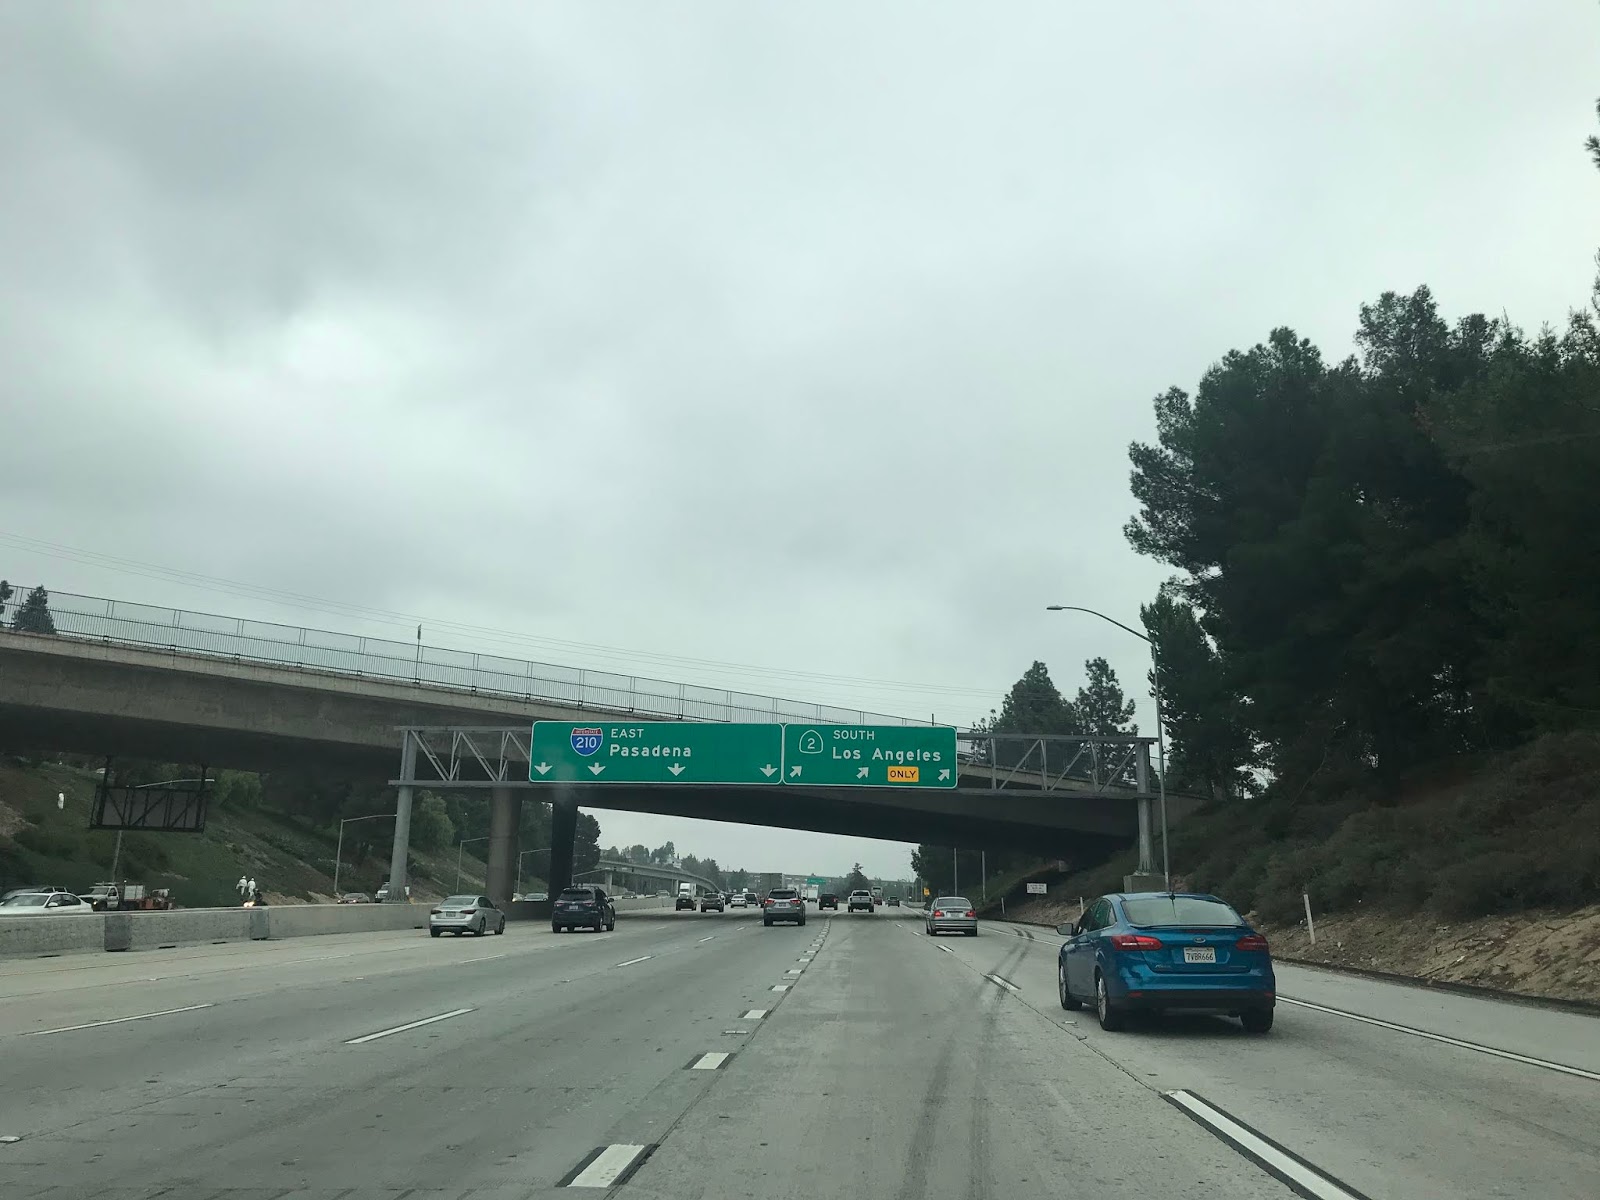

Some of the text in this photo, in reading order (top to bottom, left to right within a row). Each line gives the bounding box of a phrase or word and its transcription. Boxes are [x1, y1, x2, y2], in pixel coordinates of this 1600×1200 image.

[611, 728, 644, 738] EAST
[833, 730, 875, 740] SOUTH
[576, 737, 597, 748] 210
[807, 738, 815, 749] 2
[610, 744, 691, 757] Pasadena
[832, 747, 941, 764] Los Angeles
[890, 770, 916, 778] ONLY
[1186, 952, 1214, 961] 7VBR666
